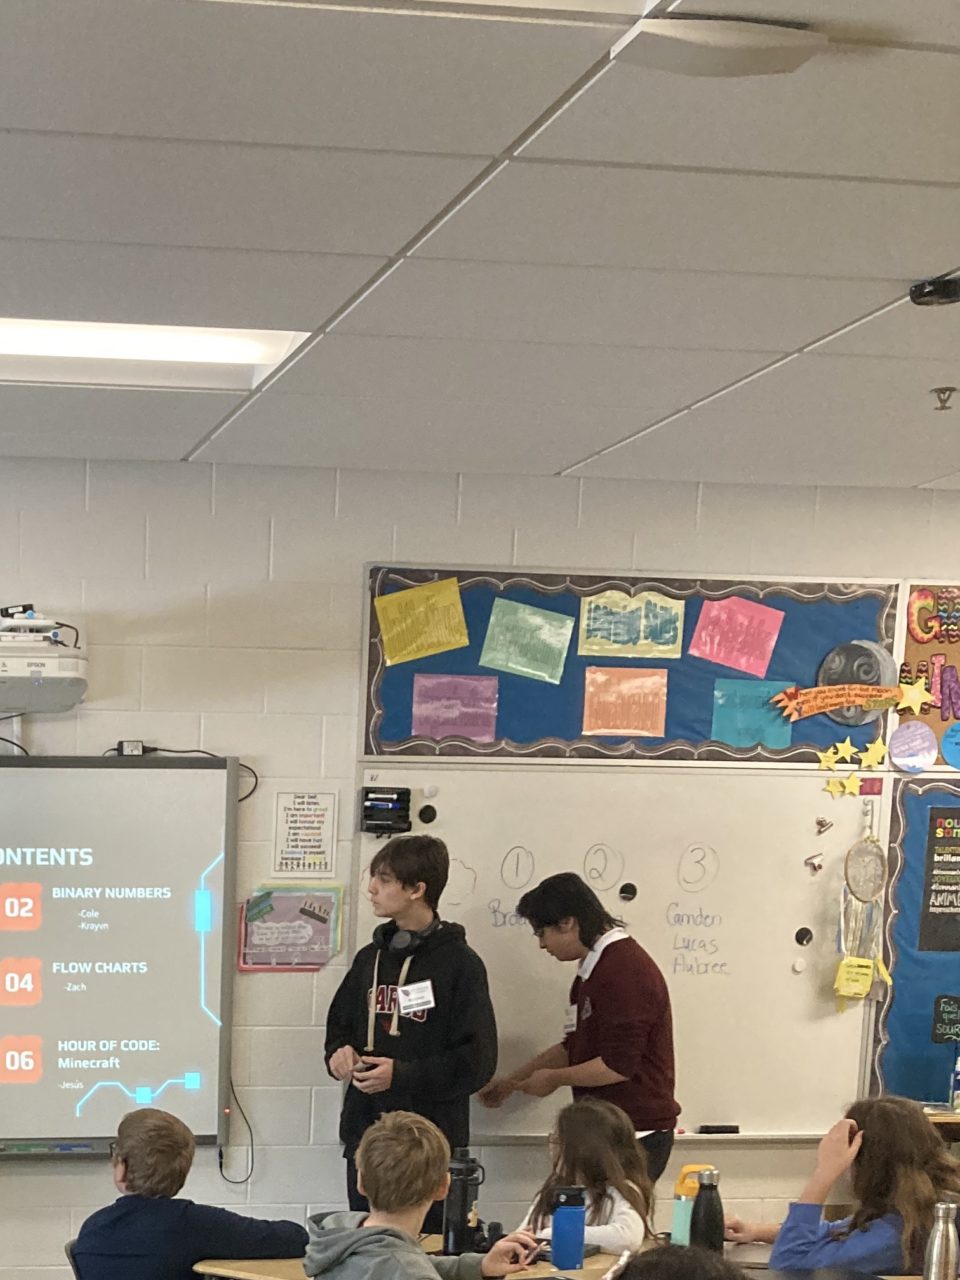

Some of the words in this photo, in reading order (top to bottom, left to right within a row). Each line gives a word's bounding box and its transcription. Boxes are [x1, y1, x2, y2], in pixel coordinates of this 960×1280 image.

[4, 897, 34, 918] 02
[52, 887, 102, 899] BINARY
[105, 887, 172, 899] NUMBERS
[77, 909, 100, 918] -Cole
[666, 902, 723, 927] Camden
[673, 934, 720, 954] Lucas
[5, 972, 34, 992] 04
[52, 962, 92, 974] FLOW
[94, 962, 148, 974] CHARTS
[63, 982, 87, 992] -Zach
[5, 1051, 35, 1070] 06
[57, 1040, 96, 1052] HOUR
[99, 1040, 118, 1052] OF
[120, 1040, 160, 1052] CODE:
[57, 1057, 121, 1069] Minecraft
